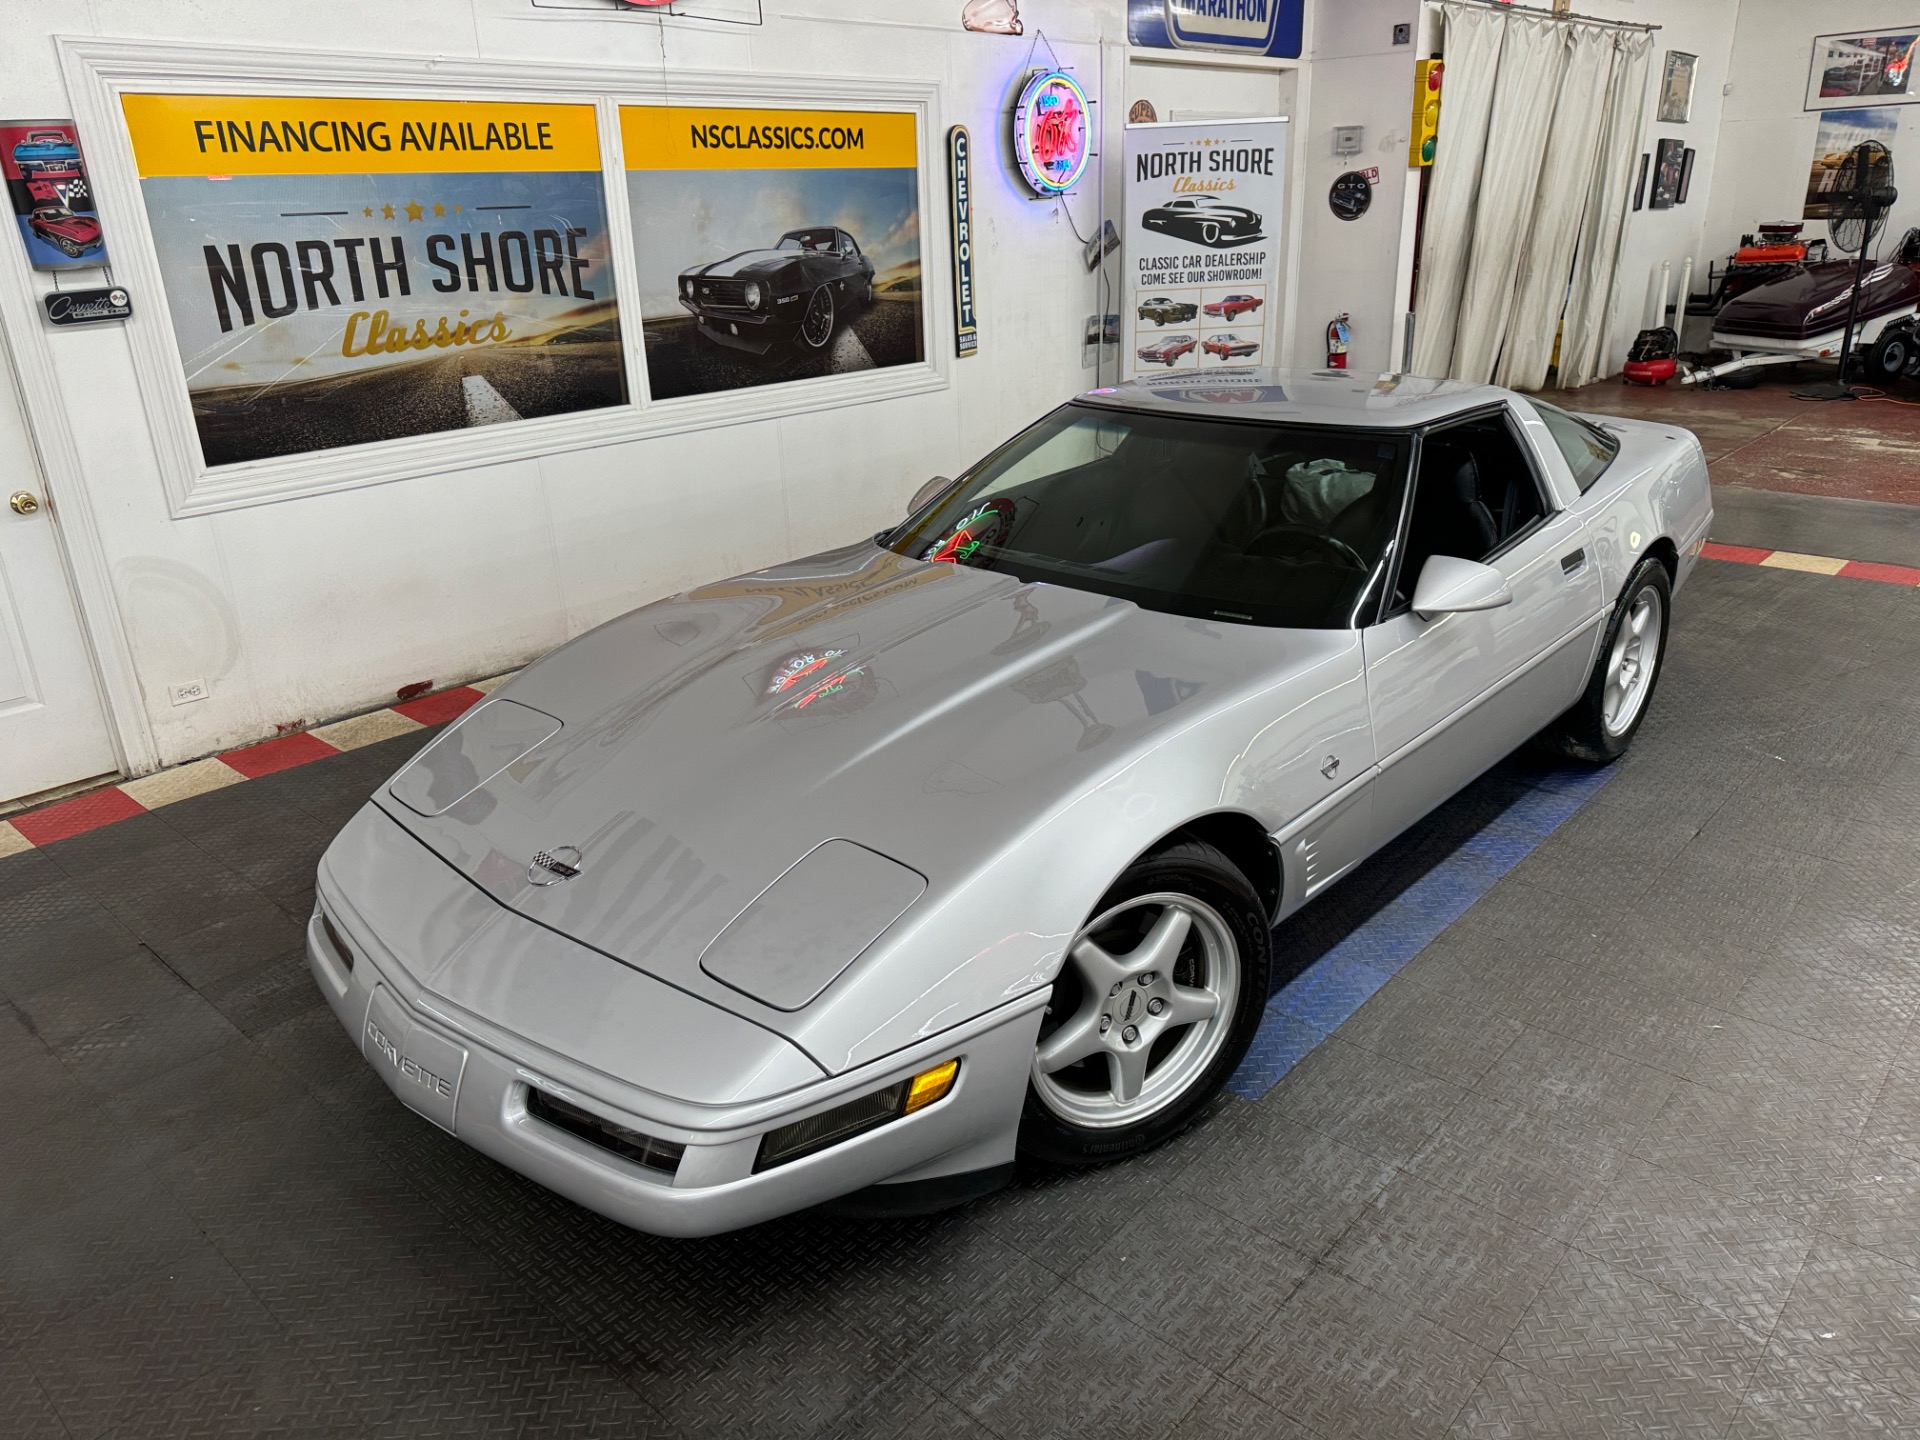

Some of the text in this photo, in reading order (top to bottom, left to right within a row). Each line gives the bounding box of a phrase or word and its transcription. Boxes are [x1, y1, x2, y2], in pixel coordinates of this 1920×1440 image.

[193, 120, 553, 153] FINANCING AVAILABLE
[690, 124, 864, 150] NSCLASSICS.COM
[1136, 148, 1275, 183] NORTH SHORE
[1360, 168, 1378, 180] OLD
[1172, 176, 1237, 193] Classics
[956, 138, 972, 323] CHEVROLET
[1139, 251, 1266, 271] CLASSIC CAR DEALERSHIP
[203, 227, 595, 333] NORTH SHORE
[1141, 268, 1262, 286] COME SEE OUR SHOWROOM!
[49, 296, 113, 320] Corvette
[341, 308, 513, 358] Classics
[367, 1019, 452, 1099] CORVETTE
